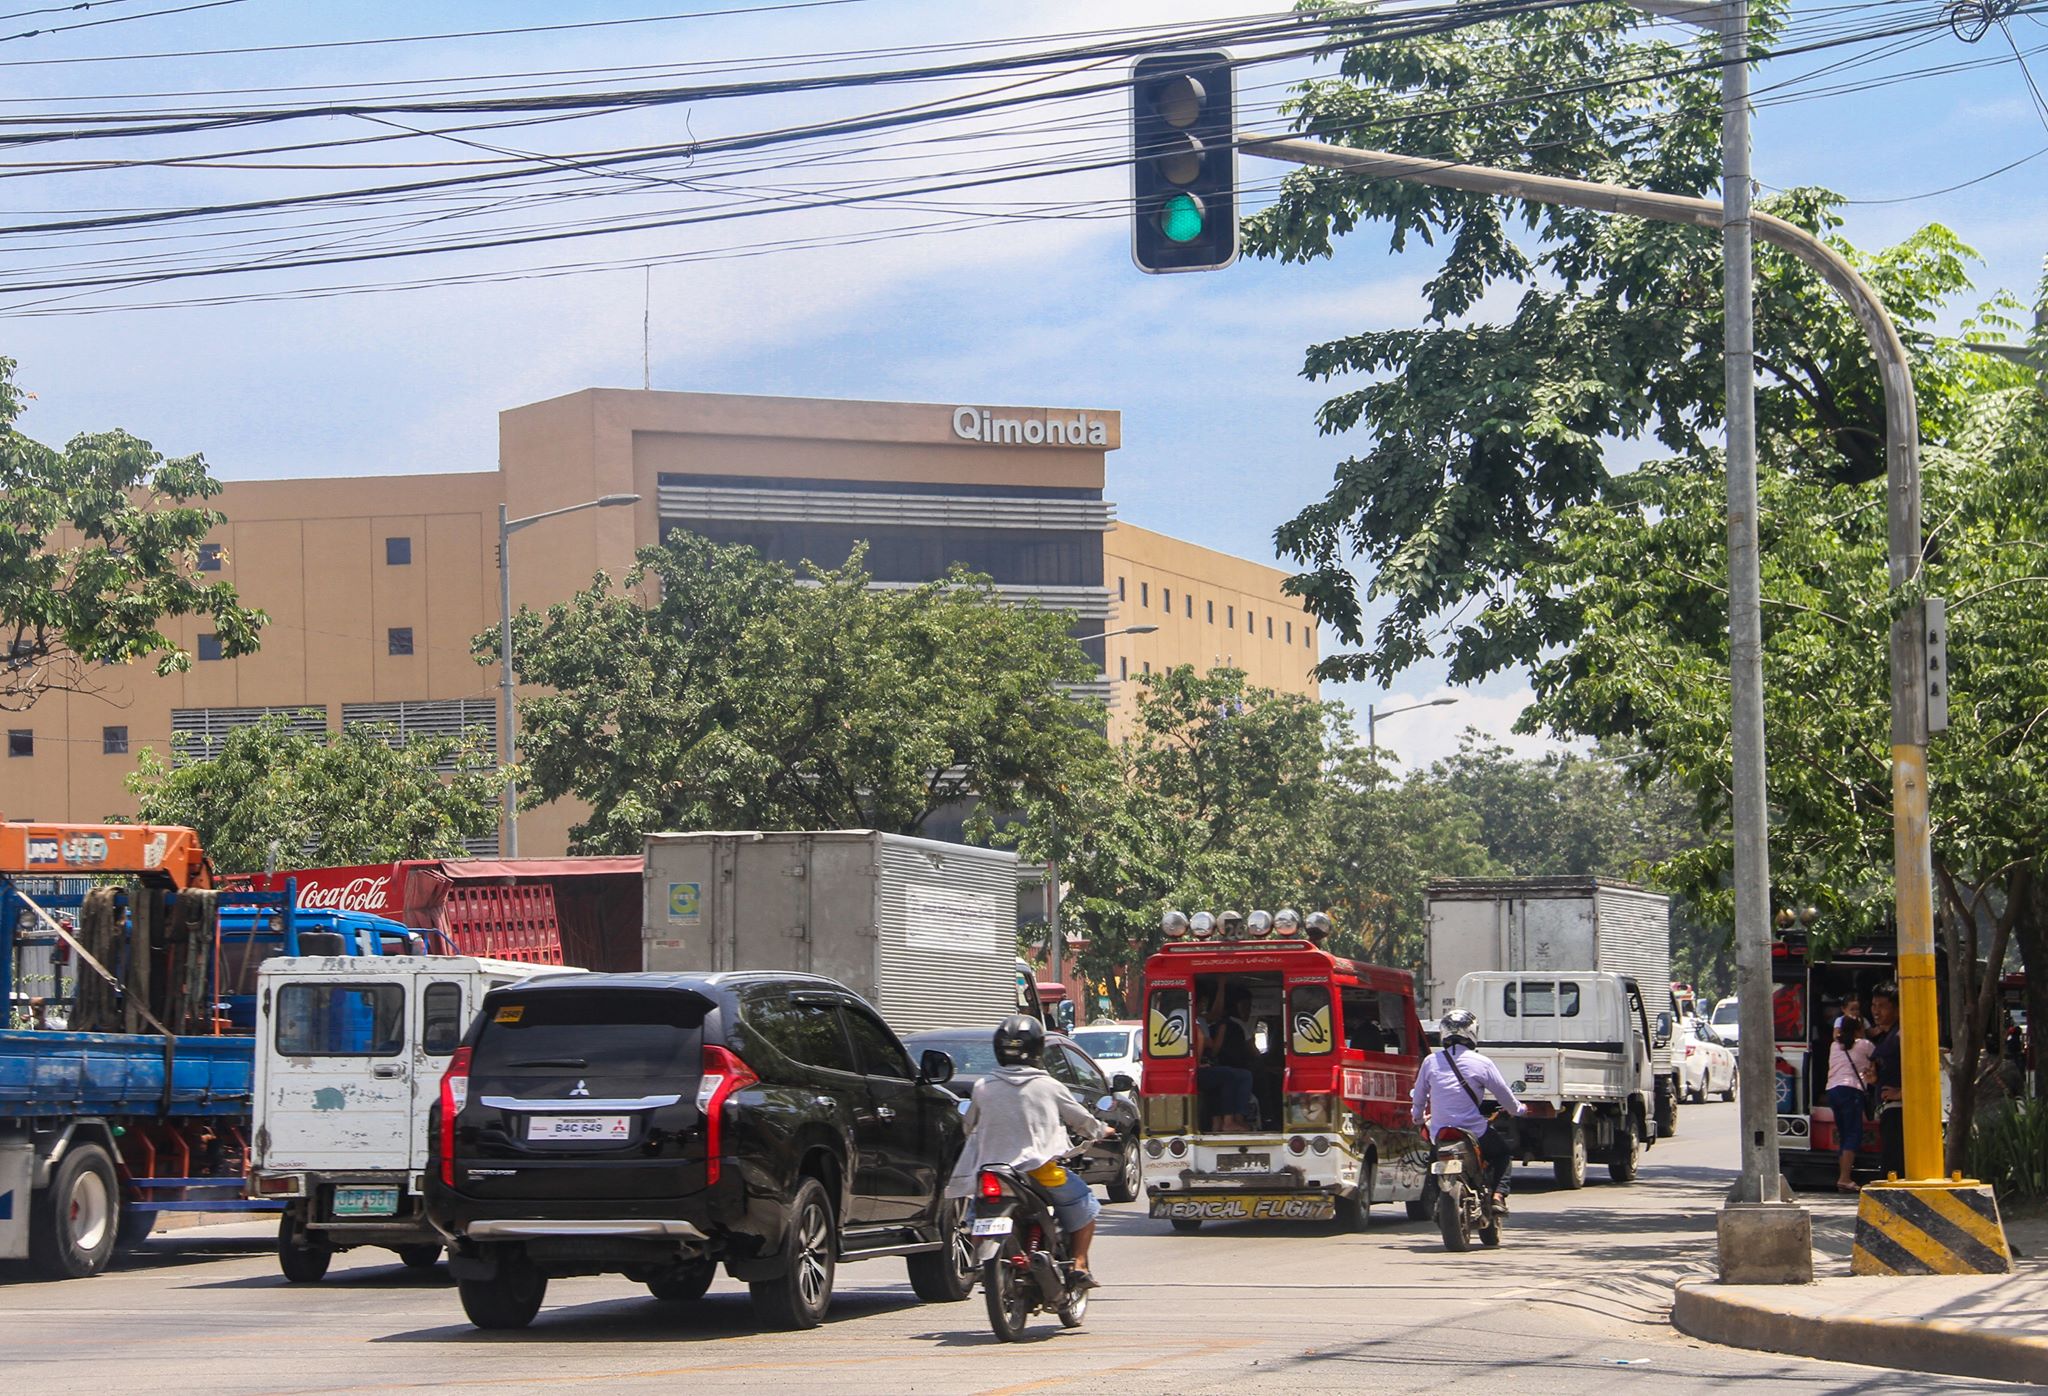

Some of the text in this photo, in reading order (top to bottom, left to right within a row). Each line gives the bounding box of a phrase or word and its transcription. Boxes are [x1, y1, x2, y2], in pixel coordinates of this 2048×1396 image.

[953, 406, 1107, 446] Qimonda
[296, 876, 392, 911] Coca-Cola
[581, 1123, 603, 1133] 649
[1153, 1200, 1331, 1218] MEDICAL FLIGHT
